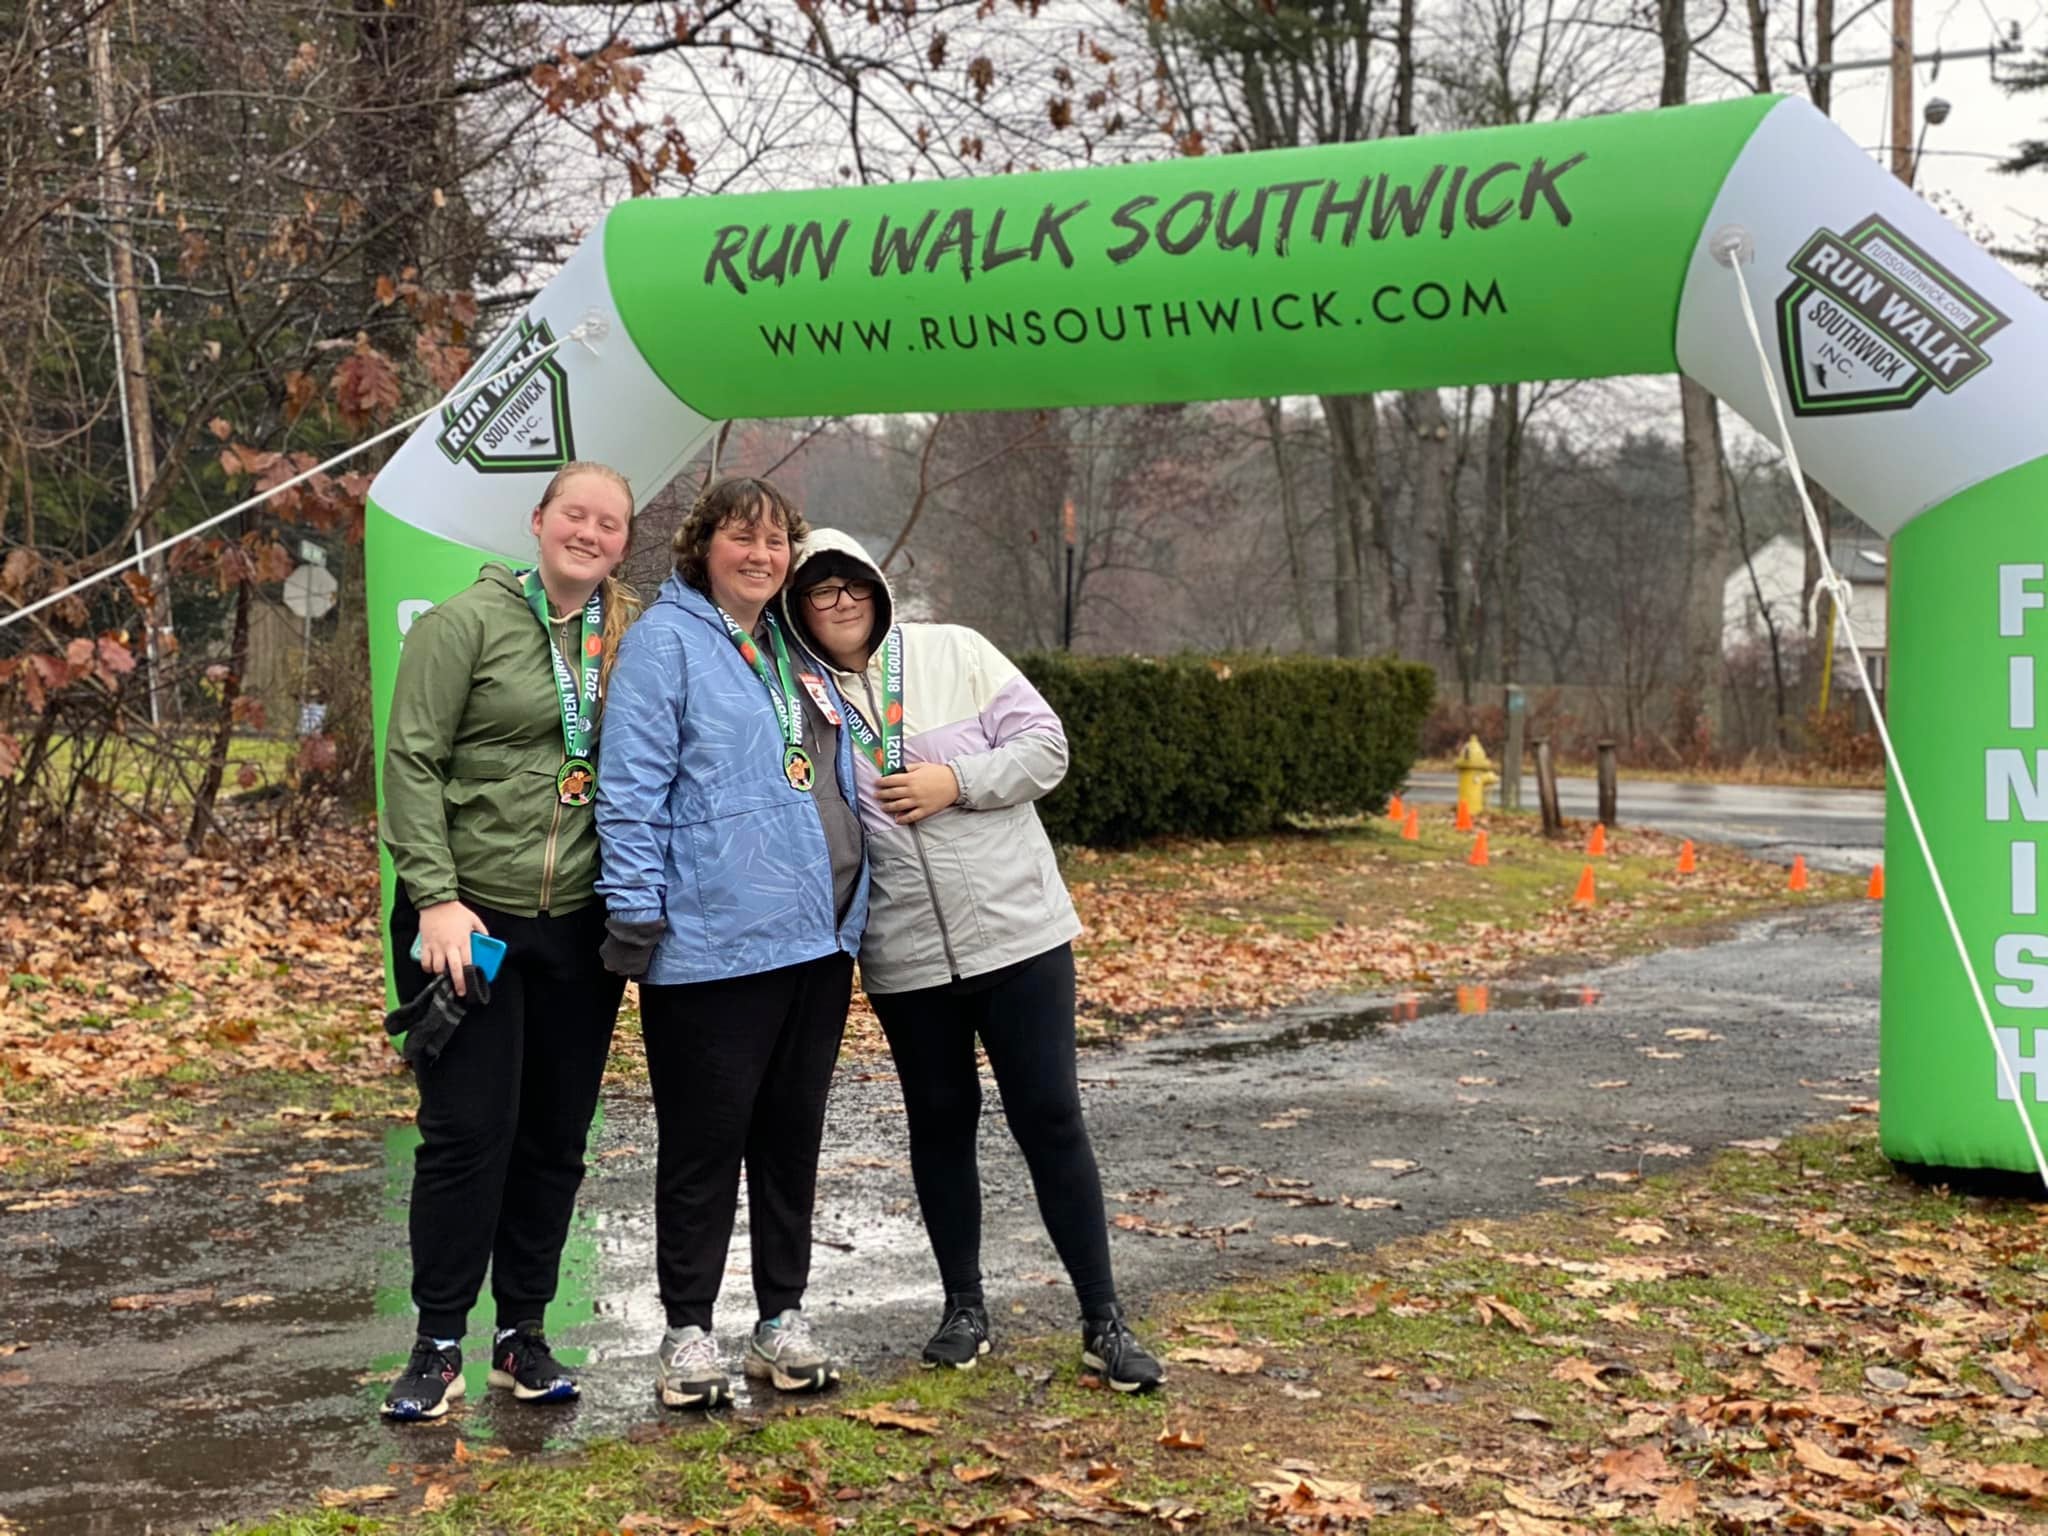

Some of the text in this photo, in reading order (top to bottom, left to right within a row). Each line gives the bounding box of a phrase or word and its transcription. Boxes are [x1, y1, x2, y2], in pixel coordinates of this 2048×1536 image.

[704, 150, 1589, 294] RUN WALK SOUTHWICK
[1807, 243, 1971, 375] RUN WALK
[1866, 241, 1973, 327] runsouthwick.com
[759, 278, 1509, 357] WWW.RUNSOUTHWICK.COM
[1808, 299, 1906, 382] SOUTHWICK
[1817, 341, 1854, 378] INC.
[446, 394, 491, 450] RUN
[487, 333, 545, 398] WALK
[483, 377, 546, 449] SOUTHWICK
[513, 415, 543, 443] INC.
[586, 605, 600, 624] 8K
[887, 632, 901, 673] GOLDEN
[585, 667, 599, 702] 2021
[887, 676, 901, 693] 8K
[562, 693, 578, 748] OLDEN
[790, 693, 803, 745] TURKEY
[855, 725, 873, 745] 8K
[887, 735, 901, 769] 2021
[1984, 562, 2048, 1103] FINISH
